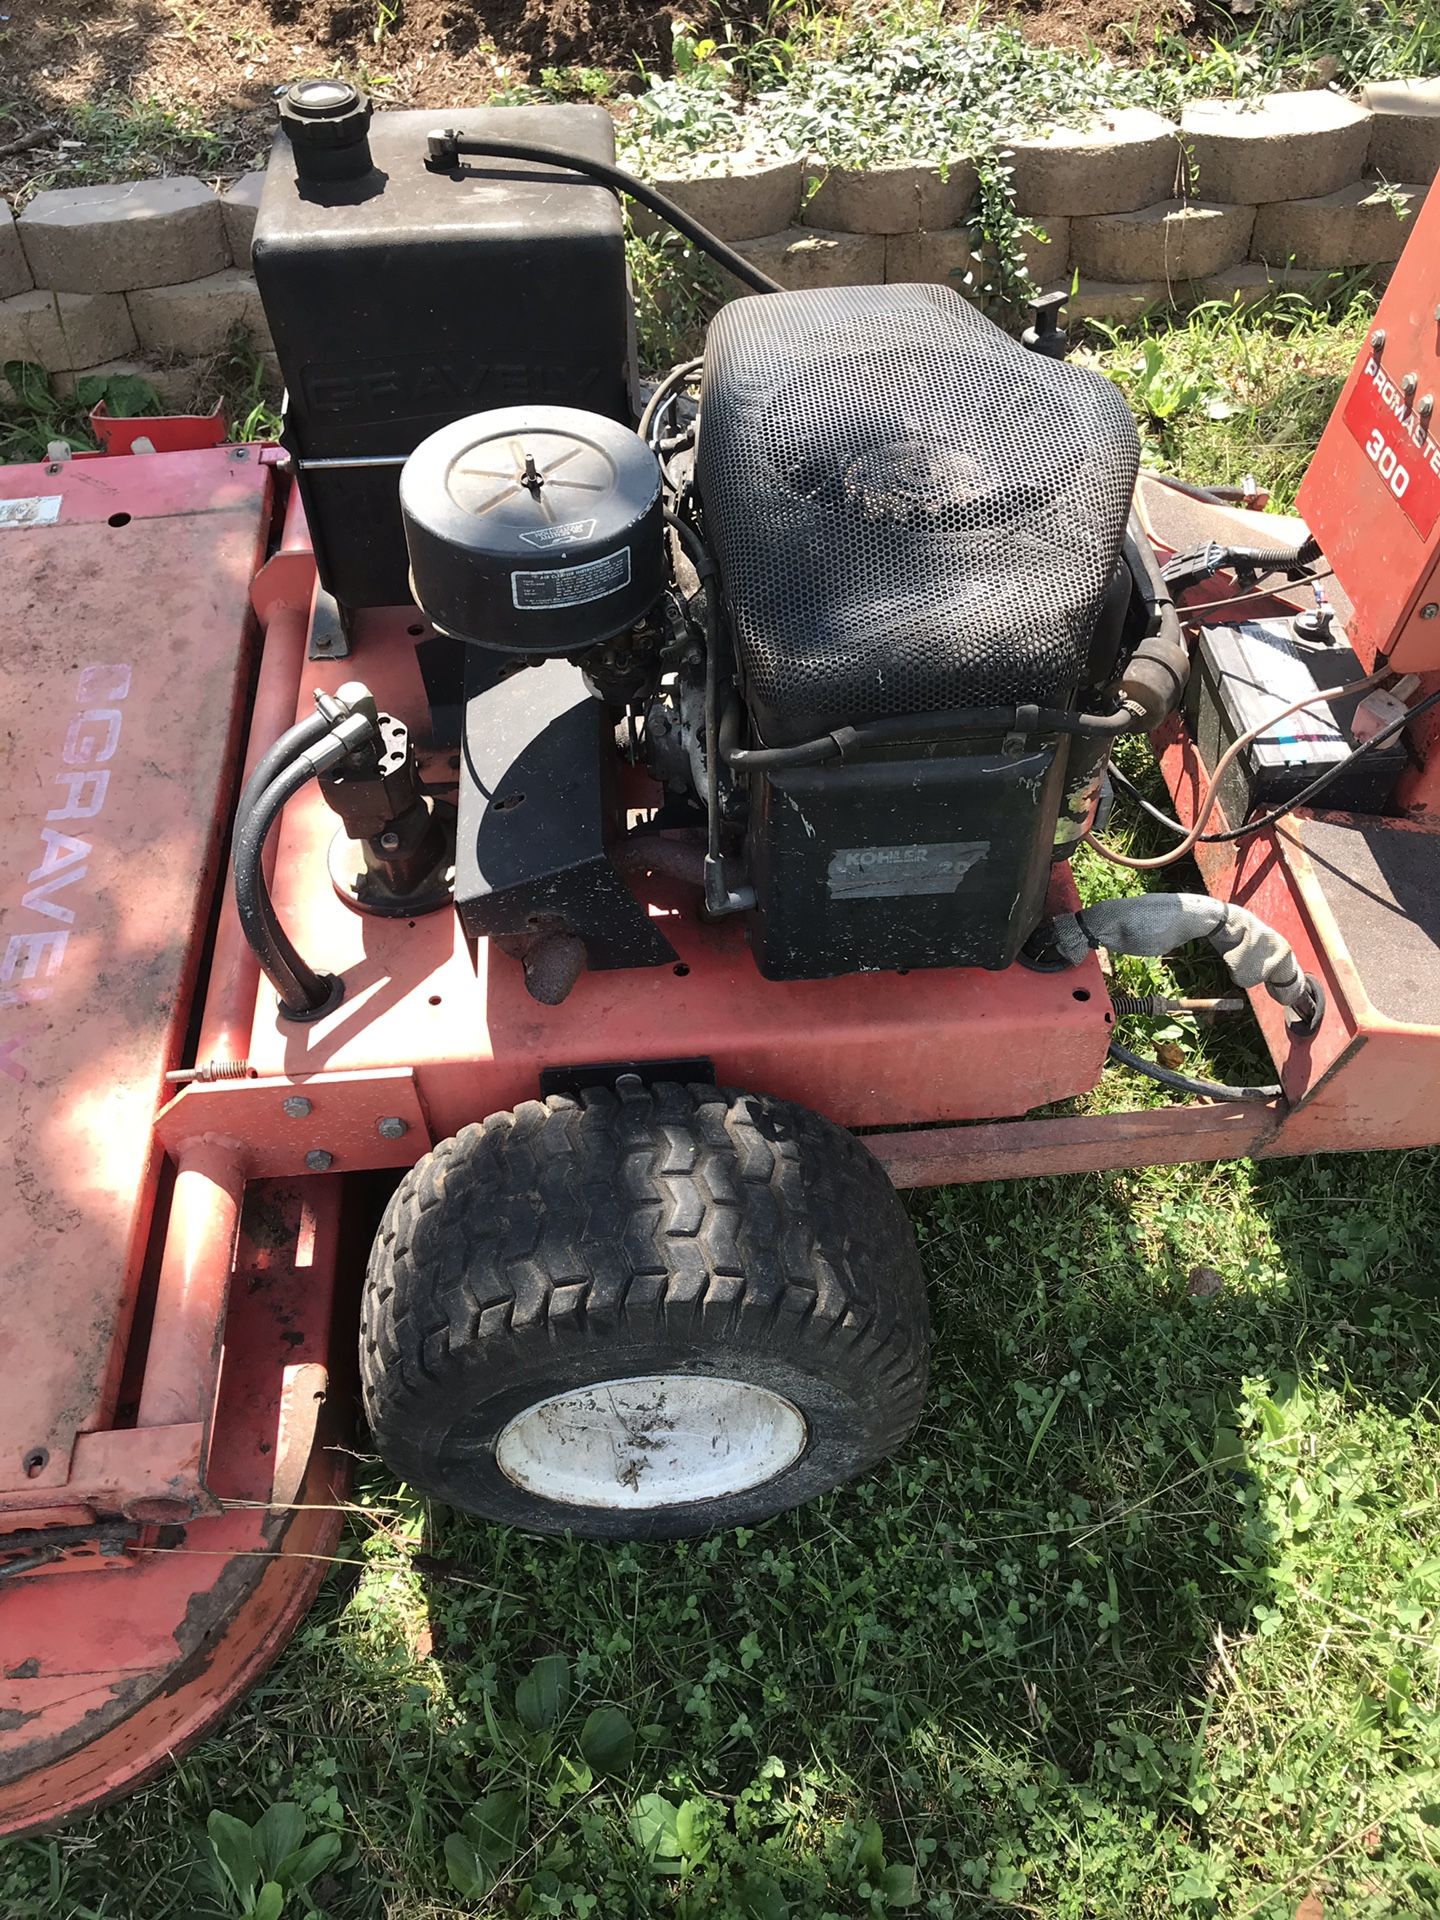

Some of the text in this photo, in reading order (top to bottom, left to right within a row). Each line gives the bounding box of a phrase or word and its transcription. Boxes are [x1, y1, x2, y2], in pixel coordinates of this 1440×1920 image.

[308, 363, 602, 412] GRAVELY
[1364, 356, 1440, 479] PROMASTE
[1365, 428, 1410, 498] 300
[844, 848, 928, 867] KOHLER
